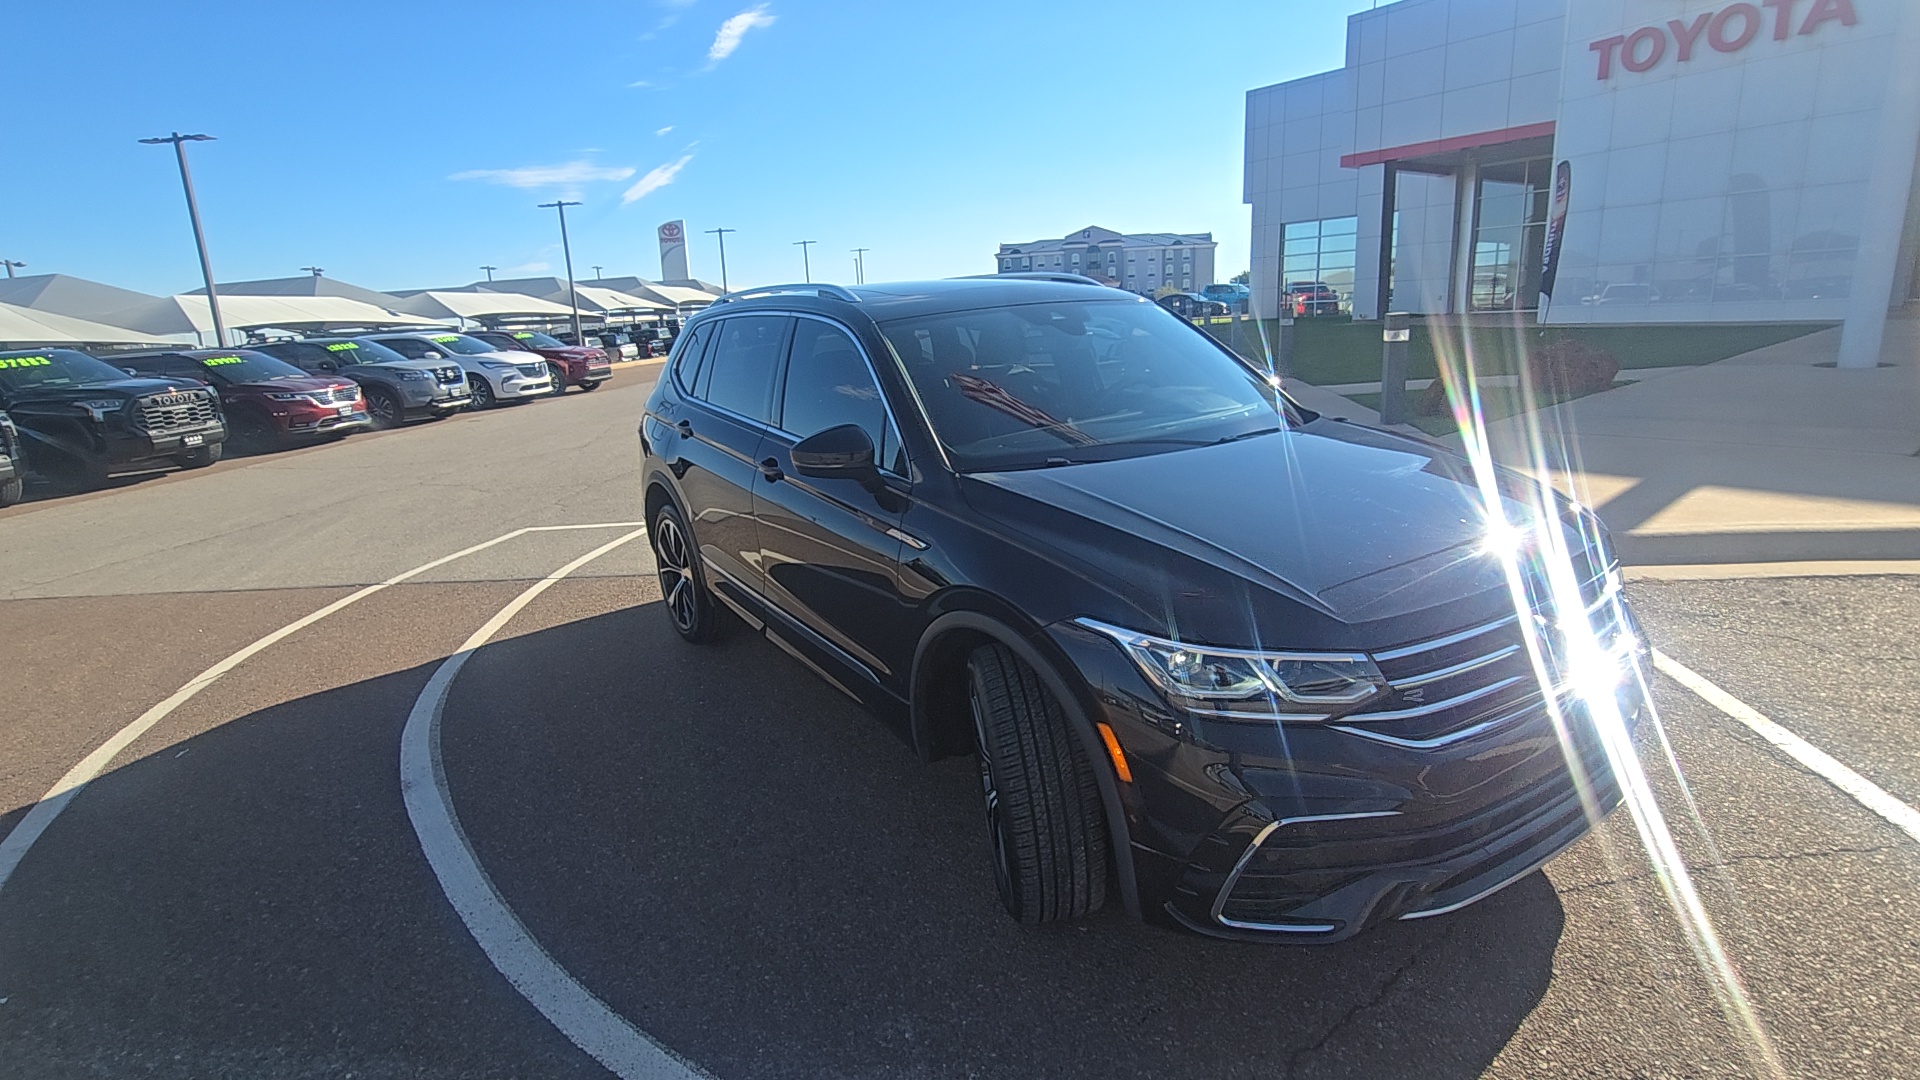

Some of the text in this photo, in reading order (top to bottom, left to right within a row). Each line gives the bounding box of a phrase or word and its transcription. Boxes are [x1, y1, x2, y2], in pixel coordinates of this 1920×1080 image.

[1589, 0, 1858, 80] TOYOTA
[1541, 219, 1558, 274] TUNDRA
[155, 392, 198, 407] TOYOTA
